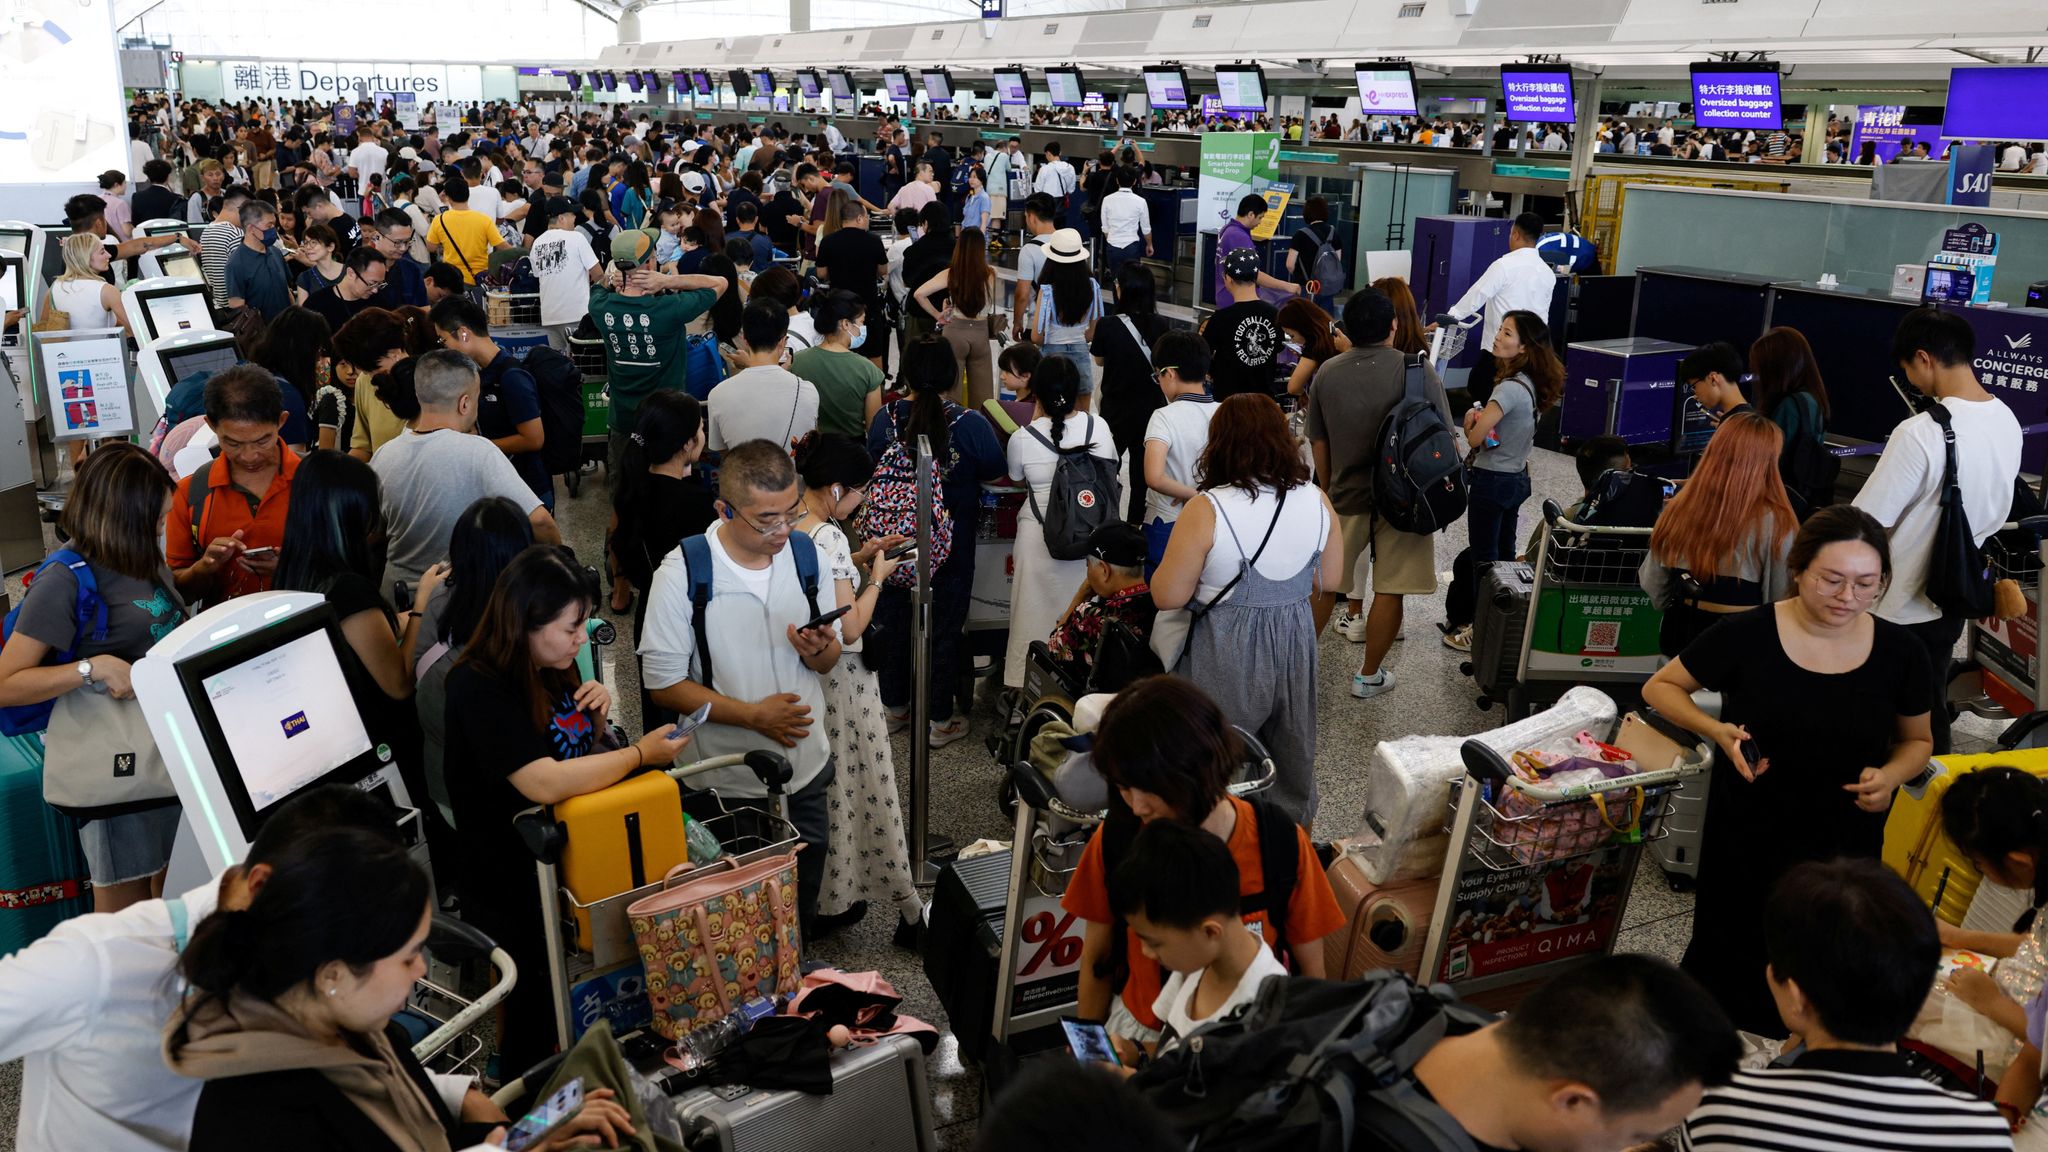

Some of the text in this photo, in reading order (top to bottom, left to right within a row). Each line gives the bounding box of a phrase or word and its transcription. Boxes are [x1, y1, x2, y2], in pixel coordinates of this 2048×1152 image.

[234, 65, 291, 90] 離港
[300, 70, 438, 95] Departures
[1508, 83, 1565, 92] 特大行李接收櫃位
[1699, 84, 1772, 95] 特大行李接收櫃位
[1539, 95, 1566, 104] baggage
[1700, 98, 1773, 109] Oversized baggage
[1513, 104, 1541, 112] collection
[1704, 109, 1771, 118] collection counter
[1268, 138, 1280, 169] 2
[1956, 173, 1991, 193] SAS
[1987, 349, 2043, 363] ALLWAYS
[1973, 358, 2048, 379] CONCIERGE
[1981, 373, 2038, 392] 禮賓服務
[1569, 595, 1650, 606] 出境就用微信支付
[290, 715, 306, 728] THAI
[1460, 876, 1484, 888] Your
[1486, 872, 1510, 884] Eyes
[1512, 870, 1522, 878] in
[1457, 880, 1526, 902] Supply Chain
[1537, 930, 1597, 953] QIMA
[1496, 943, 1530, 955] PRODUCT
[1482, 951, 1528, 966] INSPECTIONS
